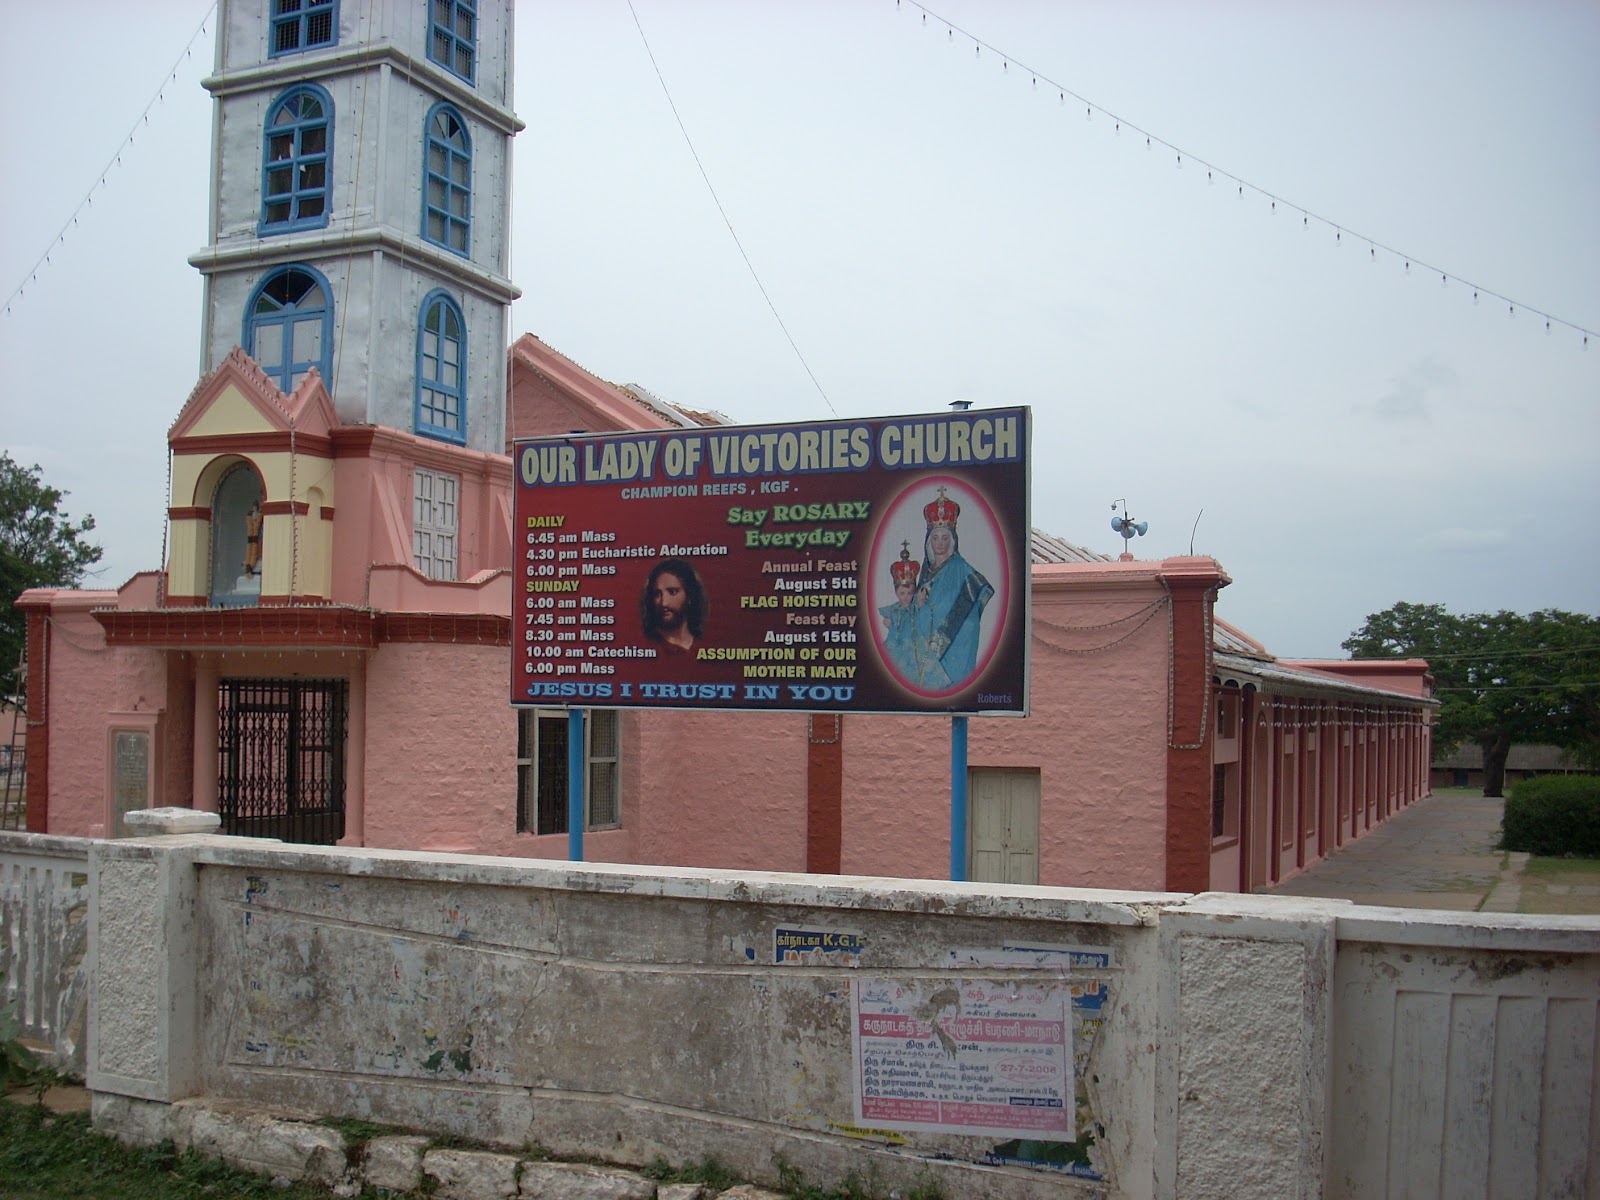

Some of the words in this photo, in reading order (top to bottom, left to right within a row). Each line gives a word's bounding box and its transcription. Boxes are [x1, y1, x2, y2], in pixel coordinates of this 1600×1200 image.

[521, 446, 577, 485] OUR
[585, 440, 656, 481] LADY
[664, 437, 701, 477] OF
[709, 427, 870, 475] VICTORIES
[880, 416, 1017, 466] CHURCH
[621, 484, 698, 500] CHAMPION
[727, 505, 768, 527] Say
[773, 502, 871, 522] ROSARY
[527, 516, 565, 528] DAILY
[527, 532, 556, 544] 6.45
[558, 533, 578, 543] am
[581, 531, 616, 543] Mass
[745, 528, 851, 549] Everyday
[526, 549, 555, 560] 4.30
[558, 551, 578, 562] pm
[582, 545, 656, 559] Eucharistic
[659, 543, 728, 557] Adoration
[526, 565, 555, 577] 6.00
[558, 566, 578, 578] pm
[581, 563, 616, 576] Mass
[762, 560, 813, 573] Annual
[817, 559, 858, 572] Feast
[526, 580, 580, 593] SUNDAY
[774, 578, 827, 593] August
[832, 577, 857, 589] 5th
[526, 597, 554, 609] 6.00
[557, 598, 577, 609] am
[580, 596, 615, 609] Mass
[740, 596, 779, 608] FLAG
[783, 595, 857, 608] HOISTING
[526, 614, 554, 625] 7.45
[557, 615, 576, 625] am
[580, 612, 615, 625] Mass
[786, 613, 826, 626] Feast
[829, 613, 857, 628] day
[525, 629, 554, 641] 8.30
[557, 631, 576, 641] am
[580, 629, 615, 641] Mass
[764, 631, 817, 645] August
[822, 631, 857, 643] 15th
[526, 646, 562, 658] 10.00
[565, 647, 584, 657] am
[588, 645, 657, 658] Catechism
[696, 648, 795, 660] ASSUMPTION
[799, 648, 820, 660] OF
[823, 648, 857, 661] OUR
[525, 662, 553, 674] 6.00
[557, 664, 577, 676] pm
[580, 662, 615, 674] Mass
[743, 665, 806, 678] MOTHER
[810, 666, 857, 678] MARY
[527, 682, 613, 698] JESUS
[620, 683, 632, 697] I
[640, 683, 735, 699] TRUST
[744, 685, 779, 699] IN
[788, 685, 854, 700] YOU
[977, 693, 1012, 703] Roberts
